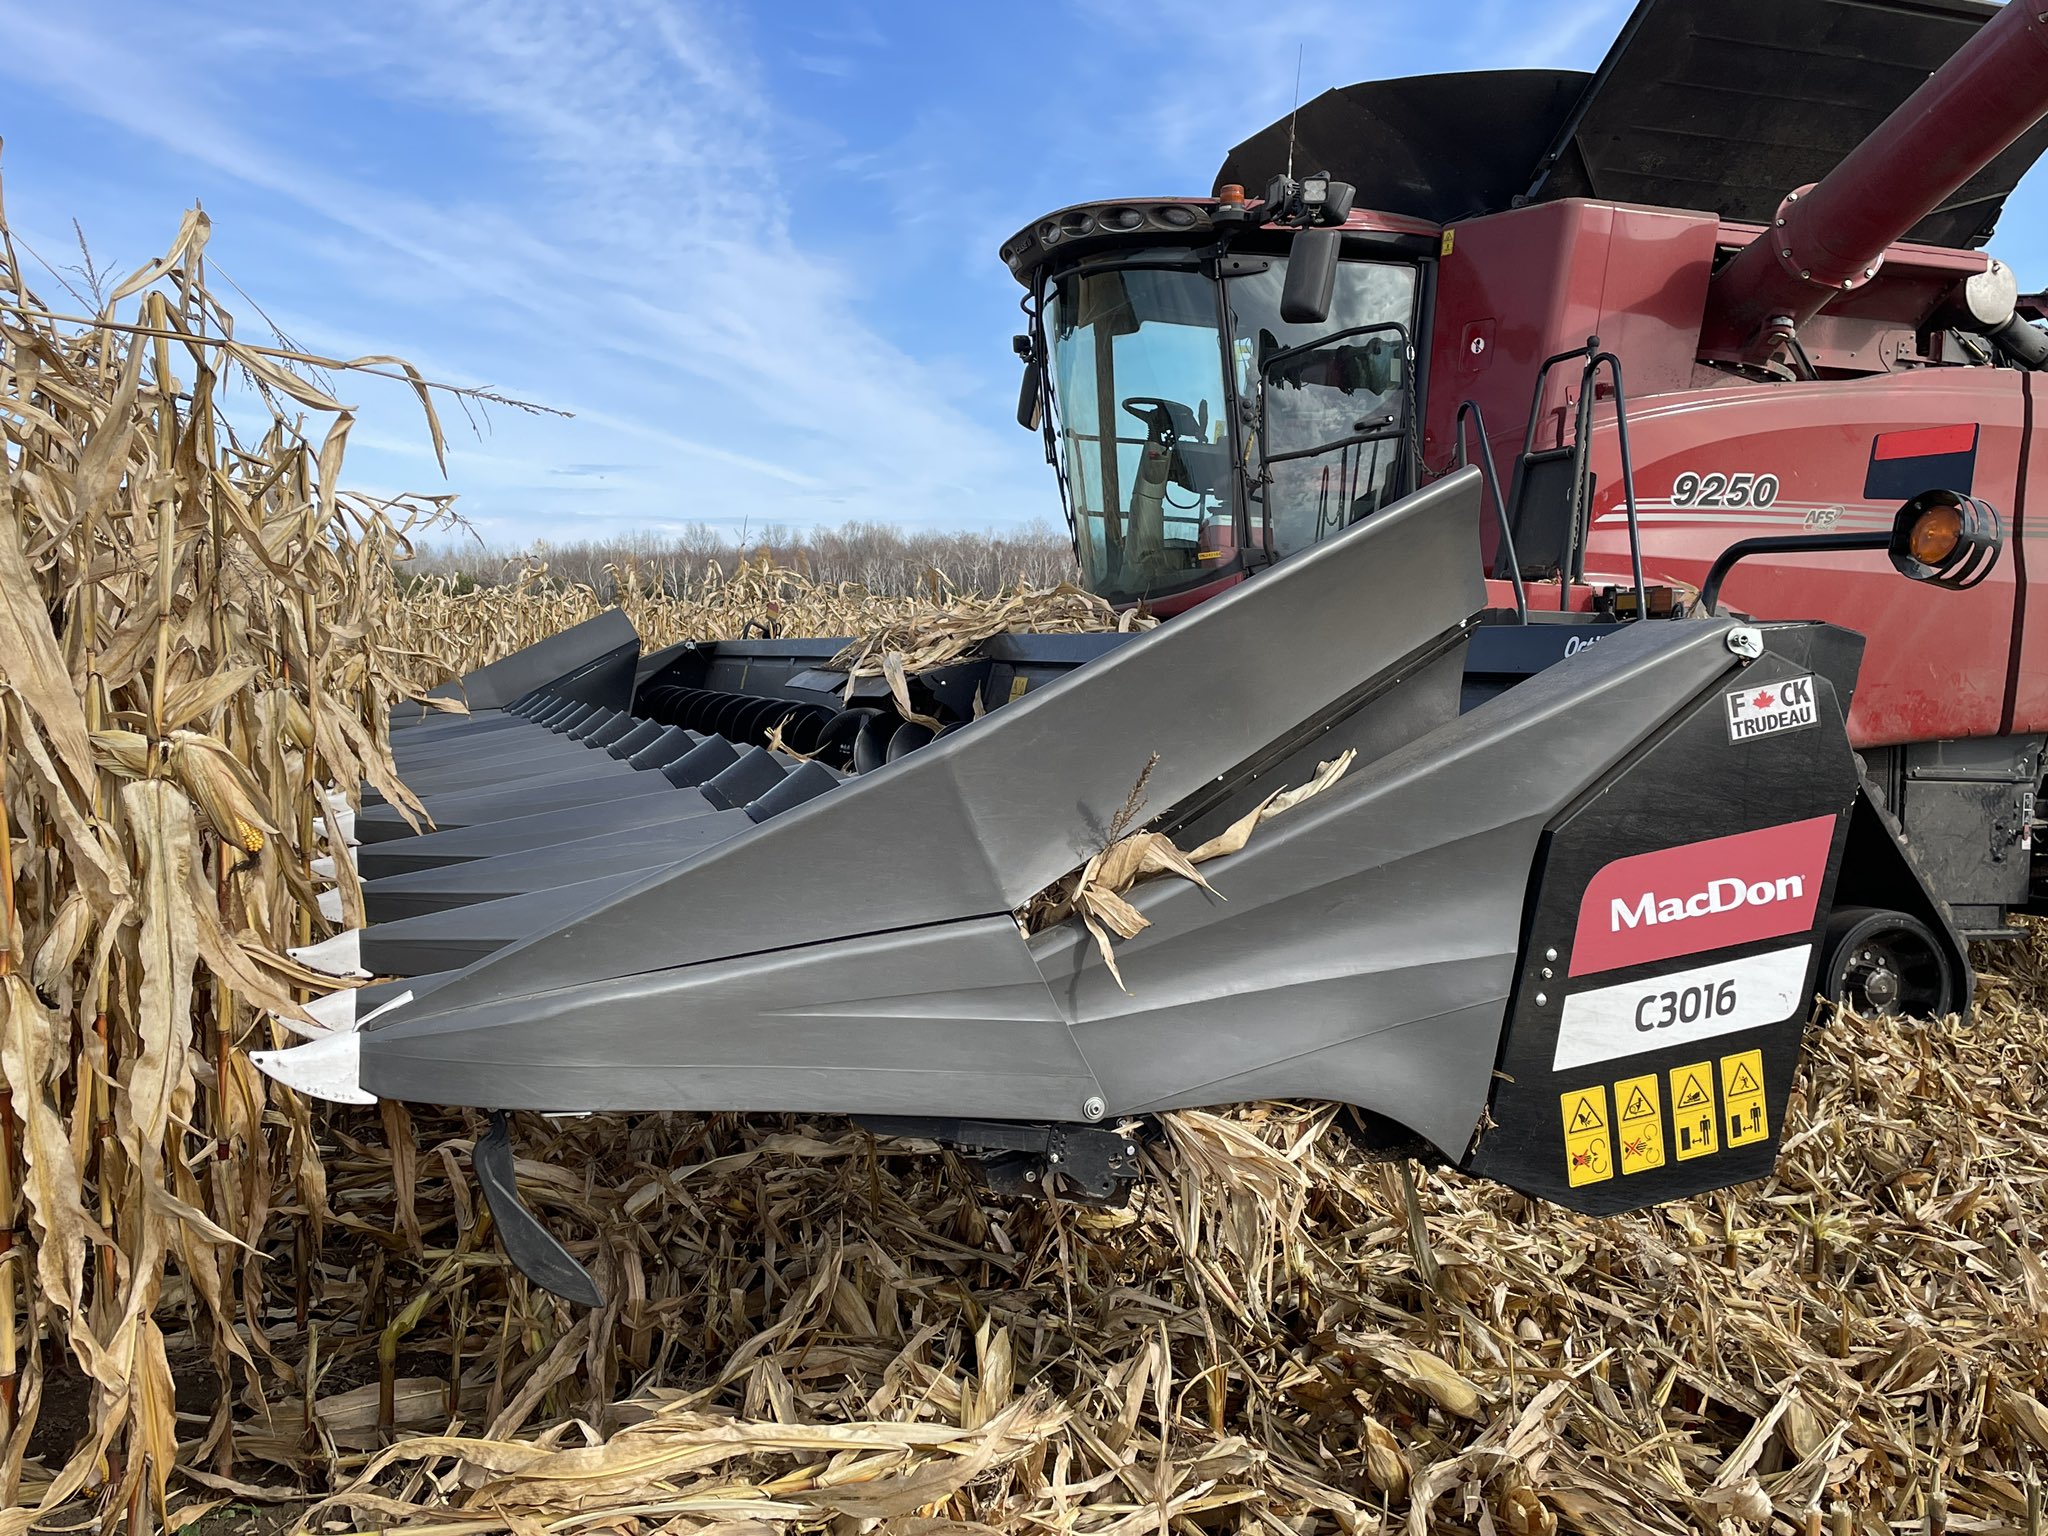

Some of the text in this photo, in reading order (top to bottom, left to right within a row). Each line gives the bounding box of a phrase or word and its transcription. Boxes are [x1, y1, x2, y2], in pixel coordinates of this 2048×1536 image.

[1671, 472, 1779, 509] 9250
[1804, 509, 1835, 524] AFS
[1732, 706, 1811, 737] TRUDEAU
[1610, 875, 1804, 932] MacDon
[1635, 978, 1737, 1032] C3016
